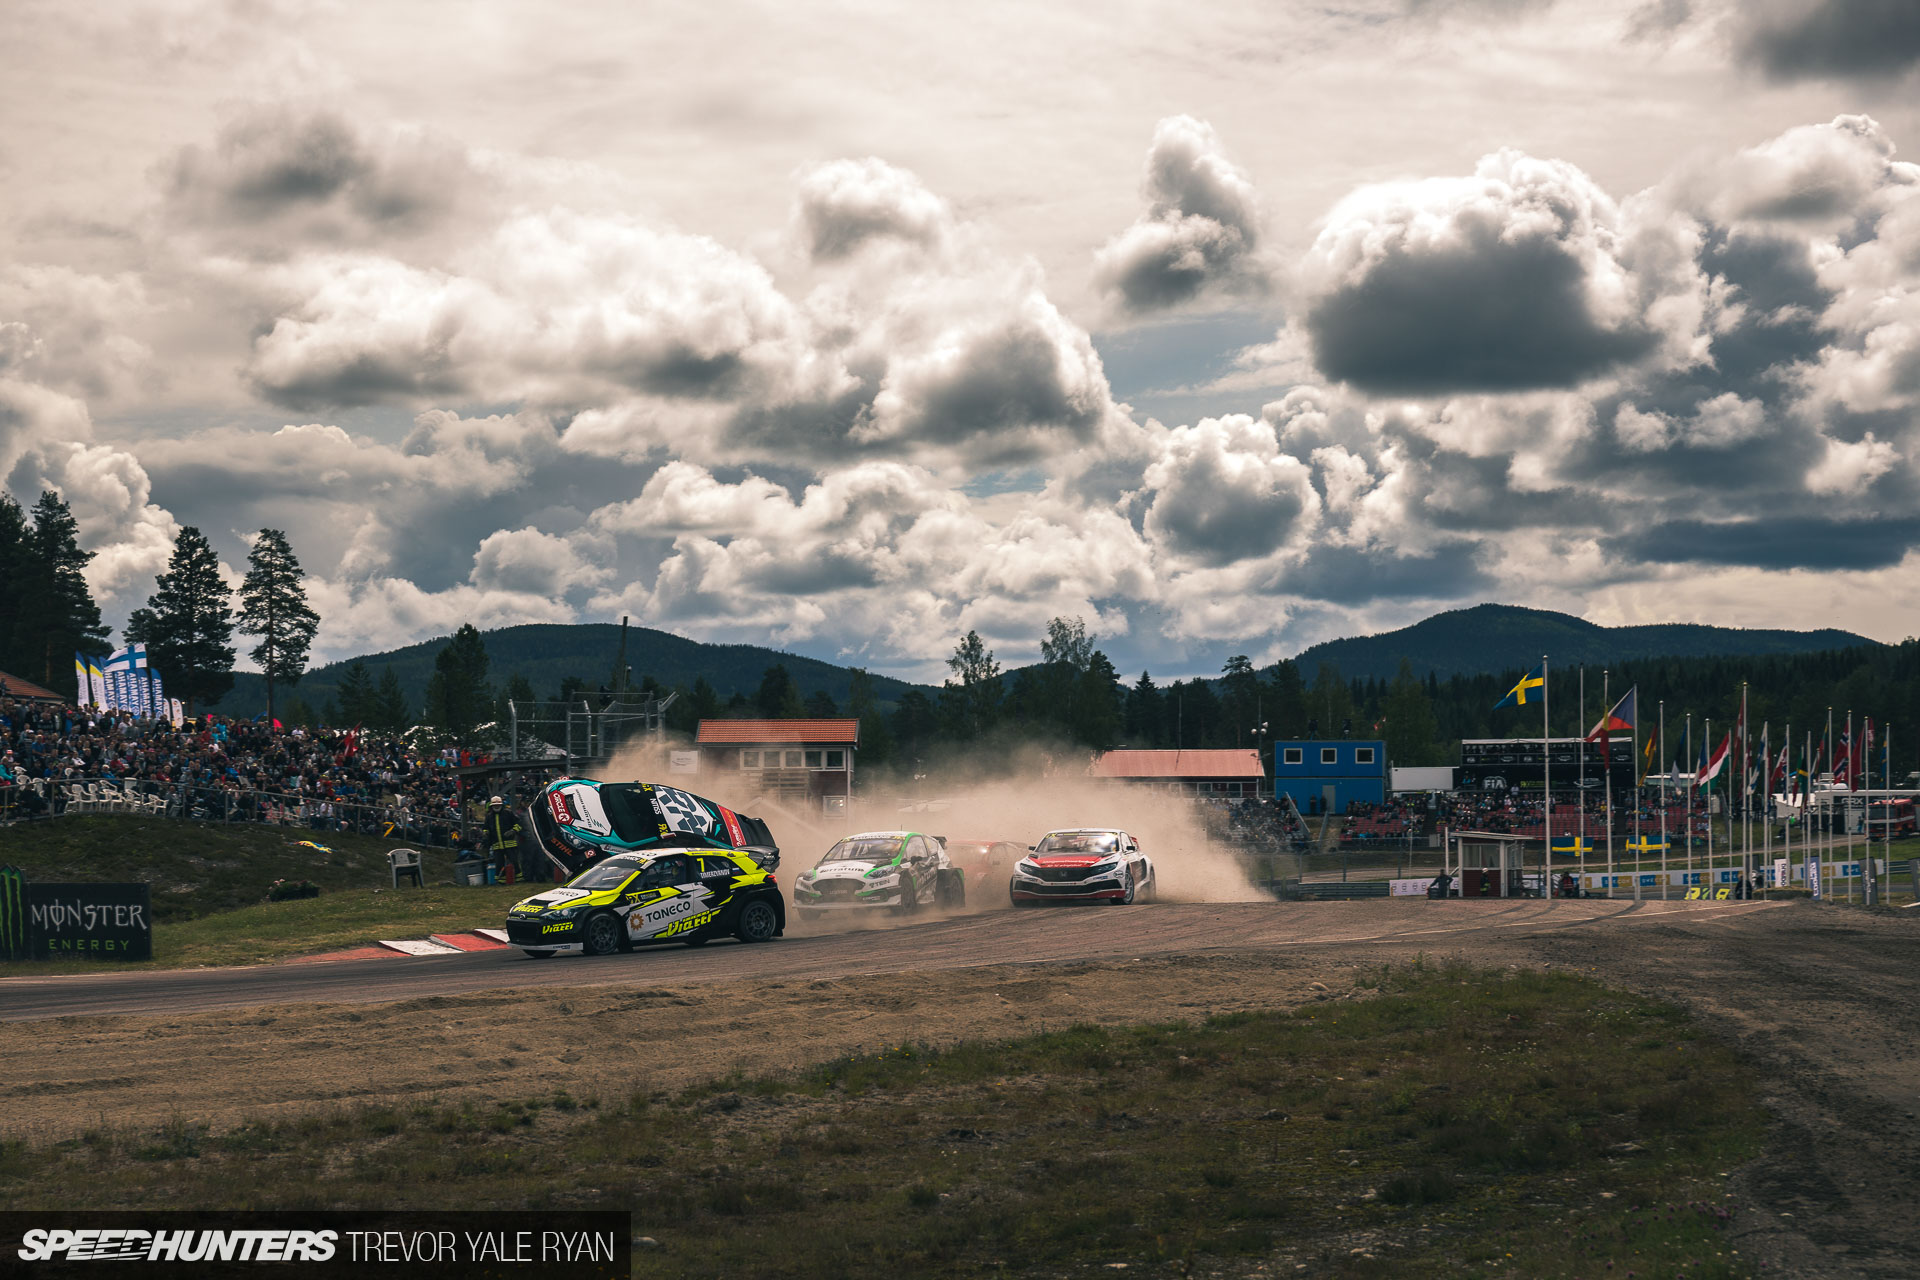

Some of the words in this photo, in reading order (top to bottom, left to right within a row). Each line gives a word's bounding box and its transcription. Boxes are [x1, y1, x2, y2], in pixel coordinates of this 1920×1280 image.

[696, 858, 705, 872] 7
[31, 899, 148, 932] MONSTER
[645, 900, 691, 923] TANECO
[48, 939, 129, 951] ENERGY
